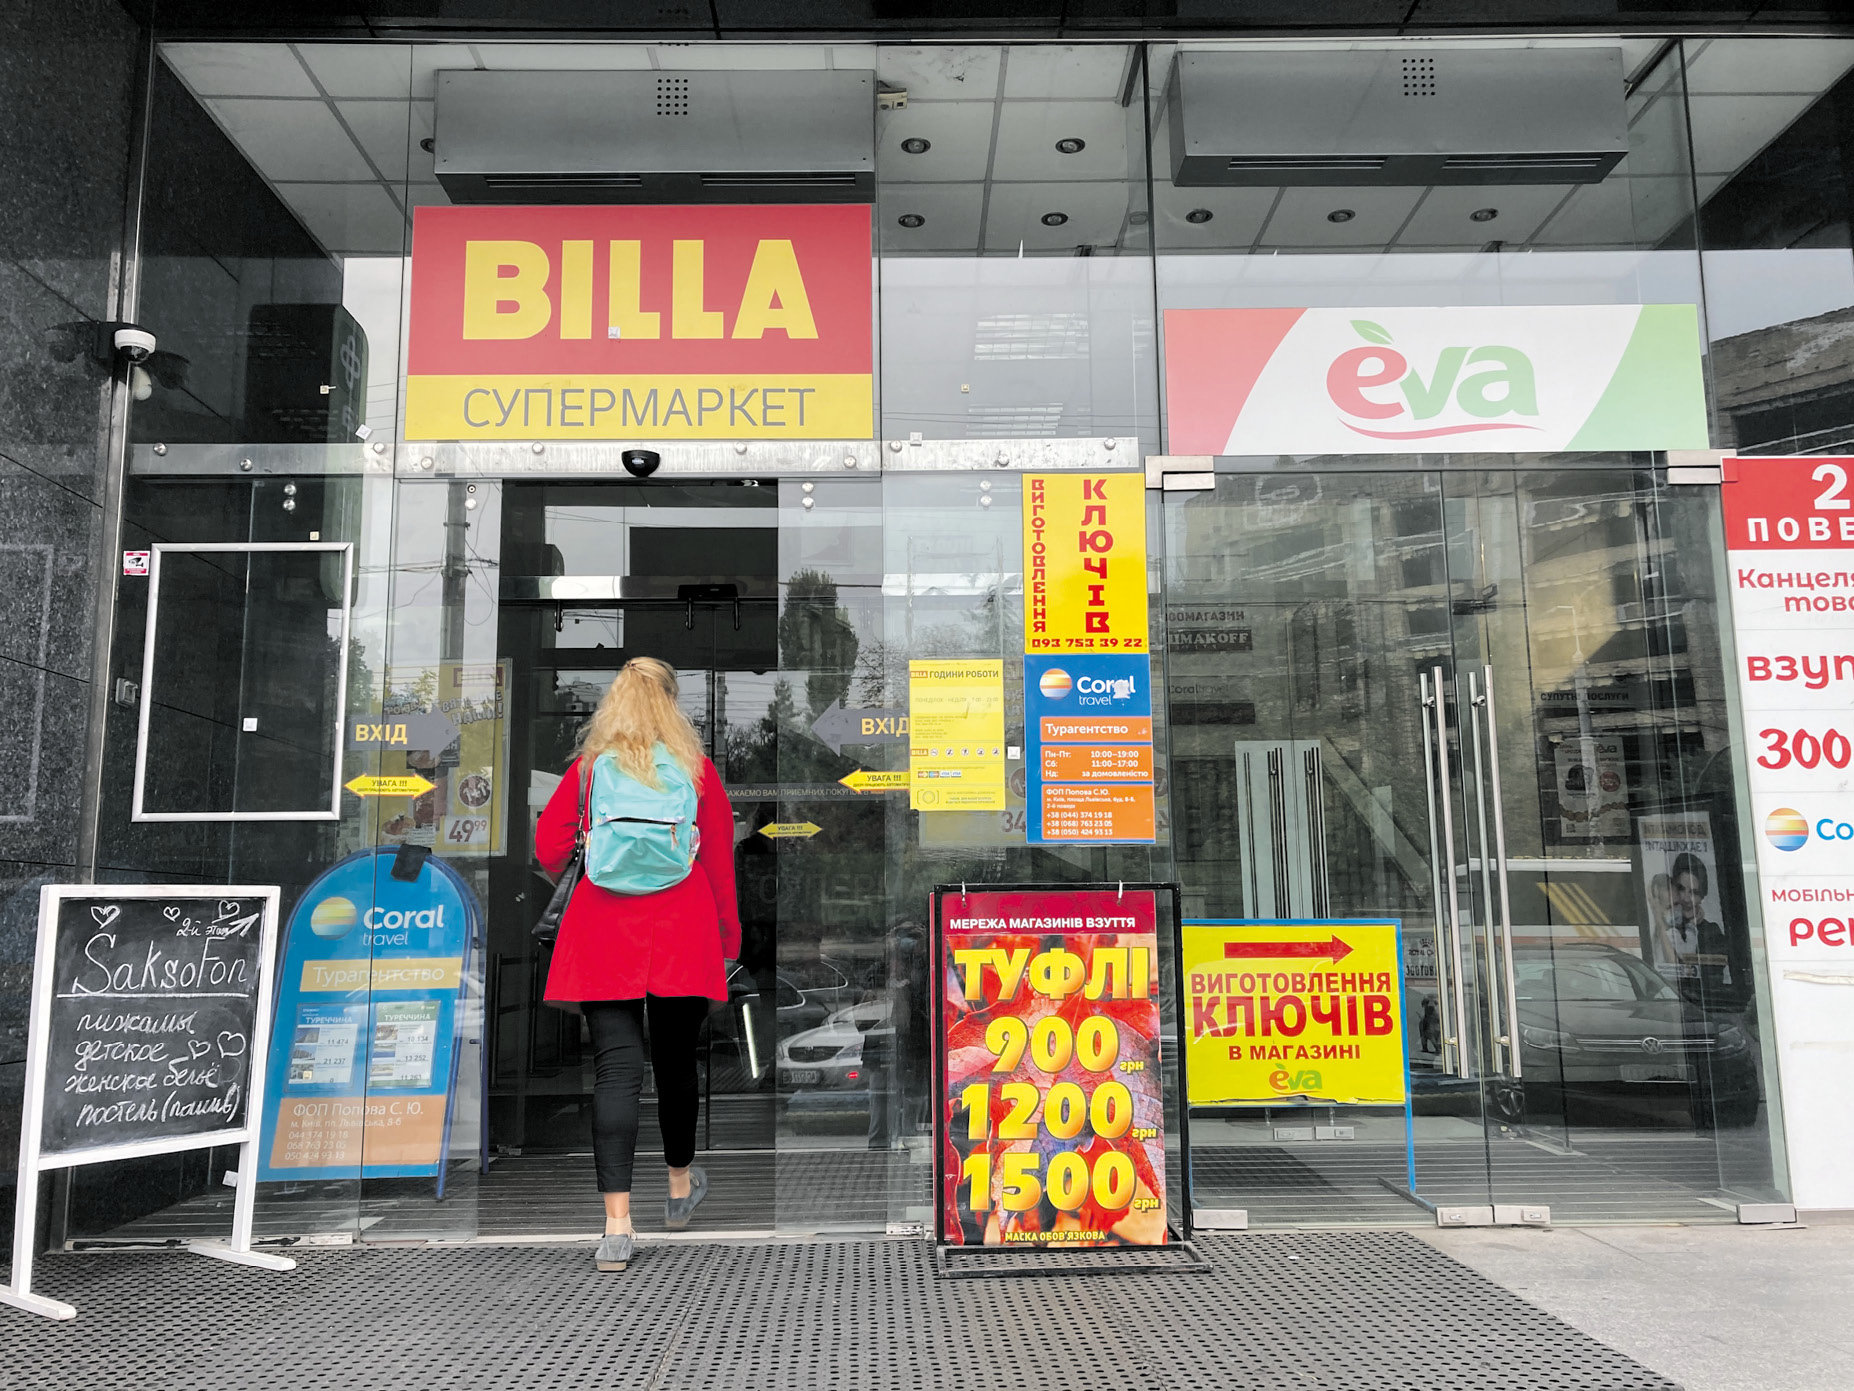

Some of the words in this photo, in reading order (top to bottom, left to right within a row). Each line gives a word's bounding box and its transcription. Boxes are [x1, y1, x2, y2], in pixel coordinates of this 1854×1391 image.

[463, 239, 819, 340] BILLA
[463, 387, 816, 428] СУПЕРМАРКЕТ
[1811, 463, 1851, 510] 2
[1031, 479, 1046, 633] ВИГОТОВЛЕННЯ
[1079, 479, 1114, 633] КЛЮЧІВ
[1737, 568, 1854, 591] Канцел
[1032, 638, 1060, 648] 093
[1065, 638, 1094, 648] 753
[1100, 638, 1118, 648] 39
[1124, 638, 1142, 648] 22
[929, 670, 964, 679] ГОДИНИ
[965, 670, 999, 678] РОБОТИ
[1078, 695, 1112, 706] travel
[355, 724, 408, 745] ВХІД
[861, 717, 910, 737] ВХІД
[1045, 723, 1129, 737] Турагентство
[371, 779, 397, 787] УВАГА
[1091, 770, 1149, 778] домовленістю
[1080, 820, 1093, 828] 763
[1094, 820, 1102, 828] 23
[363, 904, 445, 930] Coral
[950, 918, 1007, 930] МЕРЕЖА
[1008, 917, 1083, 929] МАГАЗИНІВ
[1086, 916, 1136, 929] ВЗУТТЯ
[362, 931, 408, 946] travel
[1789, 916, 1854, 947] ре
[313, 966, 445, 987] Турагентство
[954, 947, 1151, 1001] ТУФЛІ
[1191, 972, 1391, 994] ВИГОТОВЛЕННЯ
[76, 1009, 199, 1035] пижамы
[1192, 994, 1394, 1038] КЛЮЧІВ
[74, 1040, 170, 1071] детское
[985, 1015, 1120, 1073] 900
[1119, 1059, 1145, 1074] грн
[1229, 1045, 1242, 1060] В
[1250, 1044, 1360, 1060] МАГАЗИНІ
[65, 1070, 158, 1094] женское
[76, 1099, 158, 1128] постель
[293, 1103, 328, 1117] ФОП
[331, 1103, 386, 1116] Попова
[961, 1081, 1134, 1140] 1200
[1132, 1127, 1158, 1142] грн
[963, 1151, 1137, 1212] 1500
[1133, 1197, 1160, 1212] грн
[1005, 1232, 1039, 1242] МАСКА
